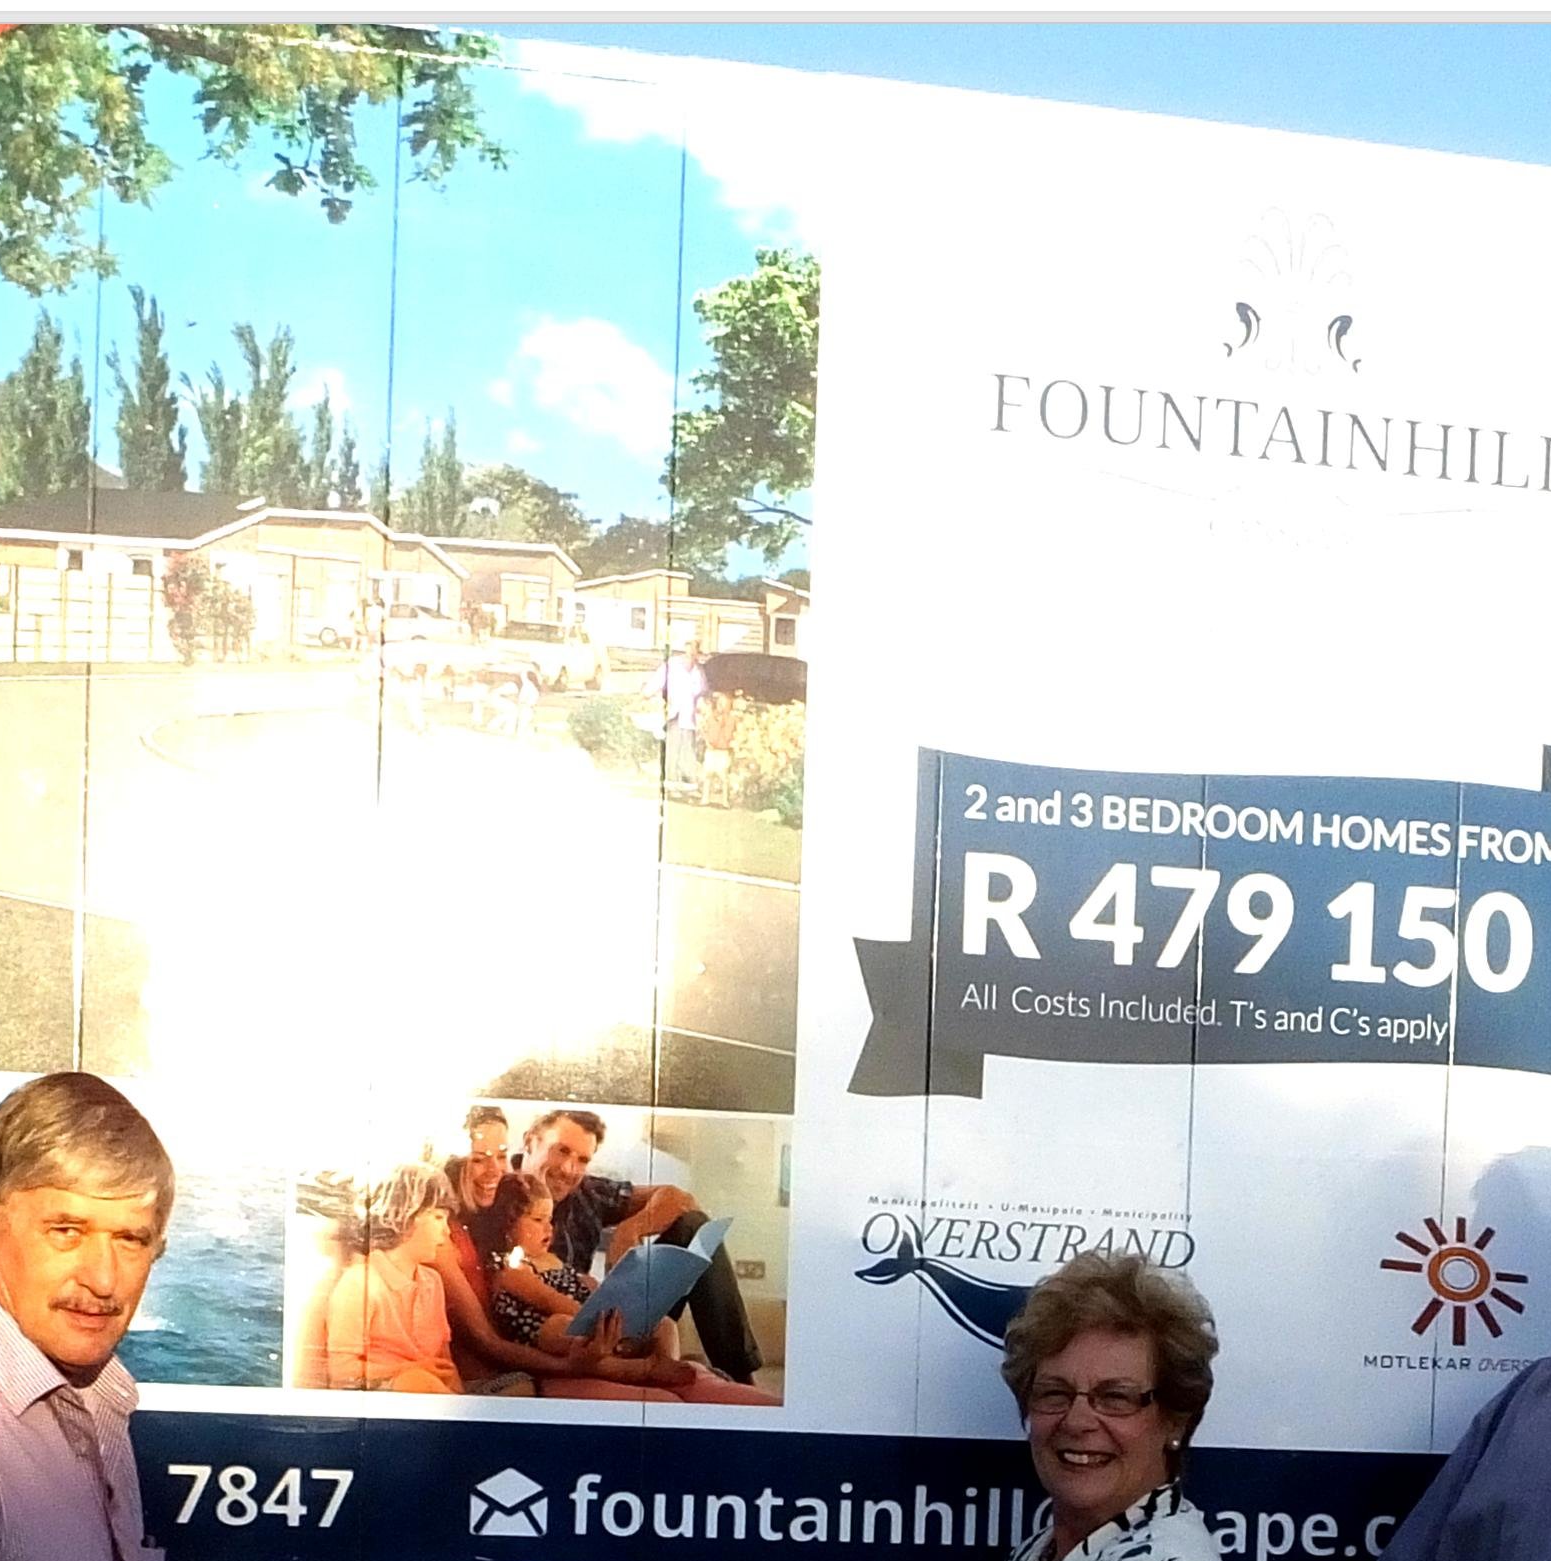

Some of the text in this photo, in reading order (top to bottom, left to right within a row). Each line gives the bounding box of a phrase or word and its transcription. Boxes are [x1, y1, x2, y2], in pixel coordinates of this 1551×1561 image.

[963, 783, 988, 820] 2
[995, 790, 1062, 828] and
[1069, 792, 1094, 830] 3
[1102, 796, 1304, 846] BEDROOM
[1312, 813, 1451, 857] HOMES
[961, 851, 1534, 993] R 479 150
[960, 983, 1448, 1046] All Costs Included. T's and C's apply
[861, 1212, 1196, 1270] OVERSTRAND
[1364, 1355, 1471, 1370] MOTLEKAR
[167, 1464, 355, 1528] 7847
